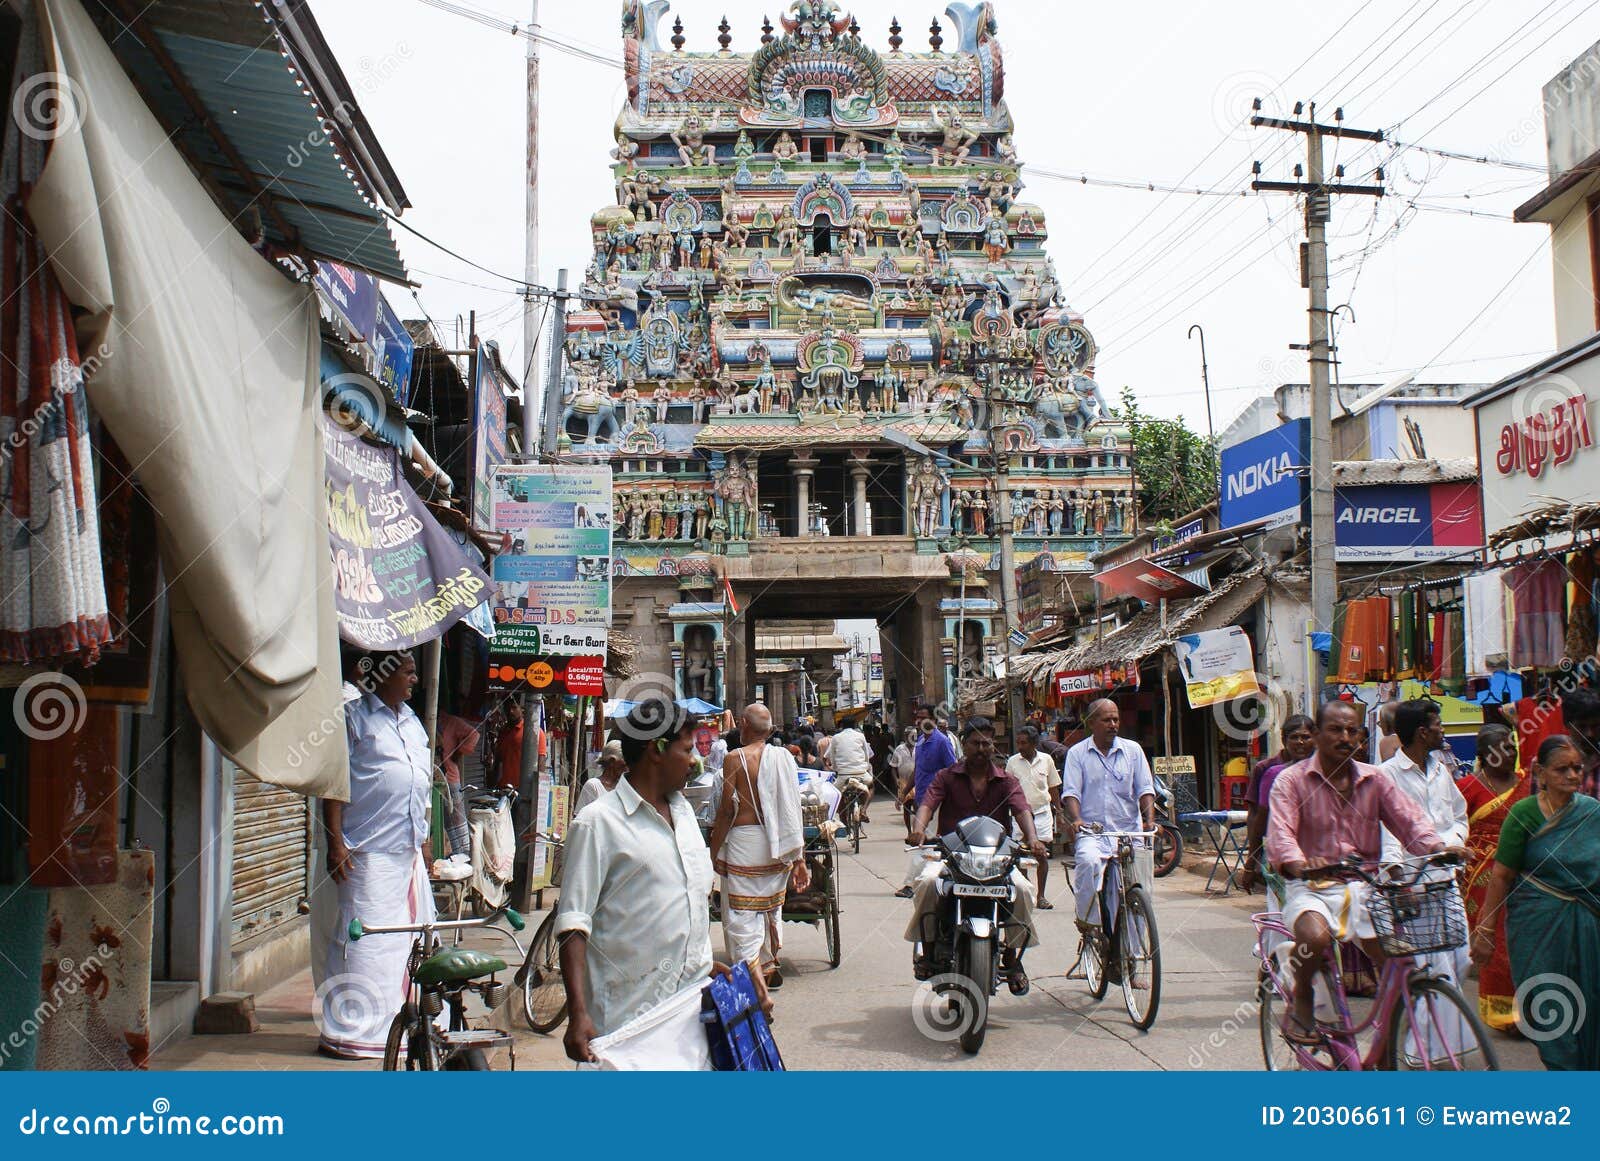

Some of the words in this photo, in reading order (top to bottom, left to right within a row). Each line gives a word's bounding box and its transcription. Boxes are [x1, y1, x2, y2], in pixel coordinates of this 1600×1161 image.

[1497, 394, 1592, 478] அமுதா
[1228, 452, 1294, 500] NOKIA
[1336, 507, 1421, 523] AIRCEL
[494, 607, 524, 623] D.S
[549, 609, 577, 624] D.S
[496, 629, 536, 637] ocal/STD
[491, 637, 536, 647] 0.66p/sec
